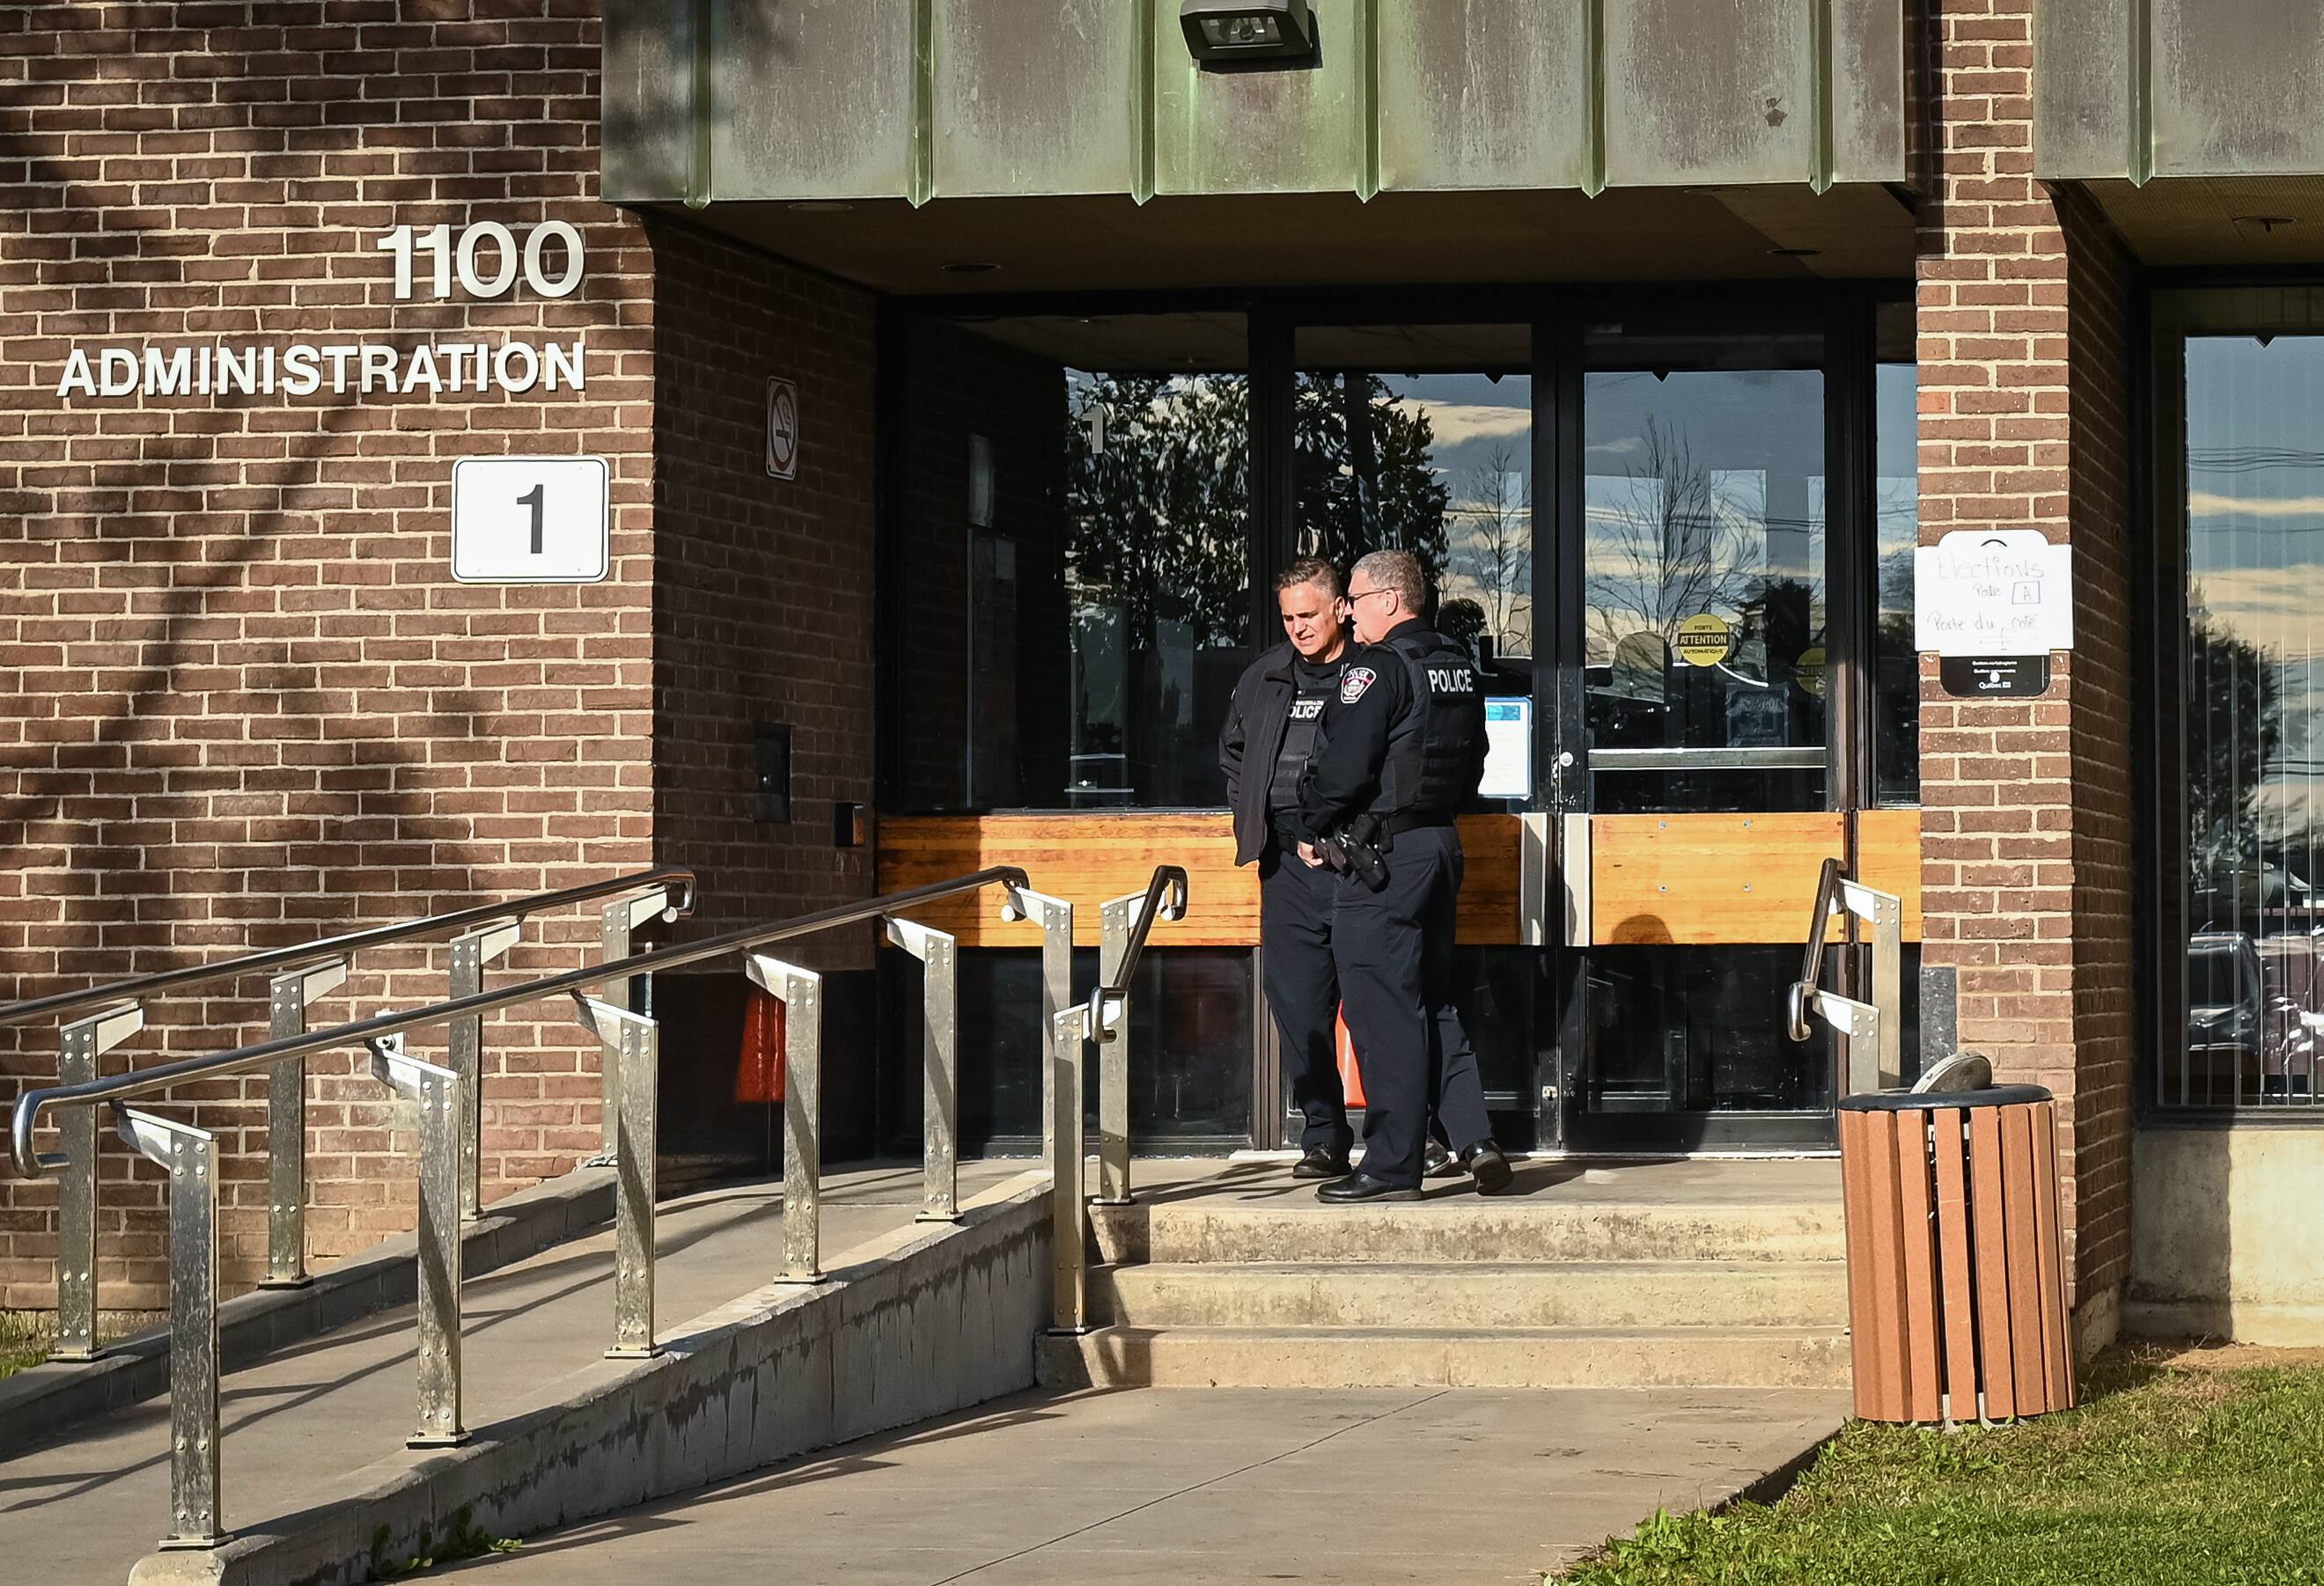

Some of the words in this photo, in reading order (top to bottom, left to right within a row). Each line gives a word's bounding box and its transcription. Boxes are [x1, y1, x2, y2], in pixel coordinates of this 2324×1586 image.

[378, 220, 585, 300] 1100
[56, 342, 585, 396] ADMINISTRATION
[1082, 405, 1103, 453] 1
[516, 483, 544, 554] 1
[2023, 585, 2032, 601] A
[1974, 612, 1994, 630] du
[1680, 634, 1727, 645] ATTENTION
[1428, 669, 1474, 693] POLICE
[1288, 705, 1322, 719] OLIC
